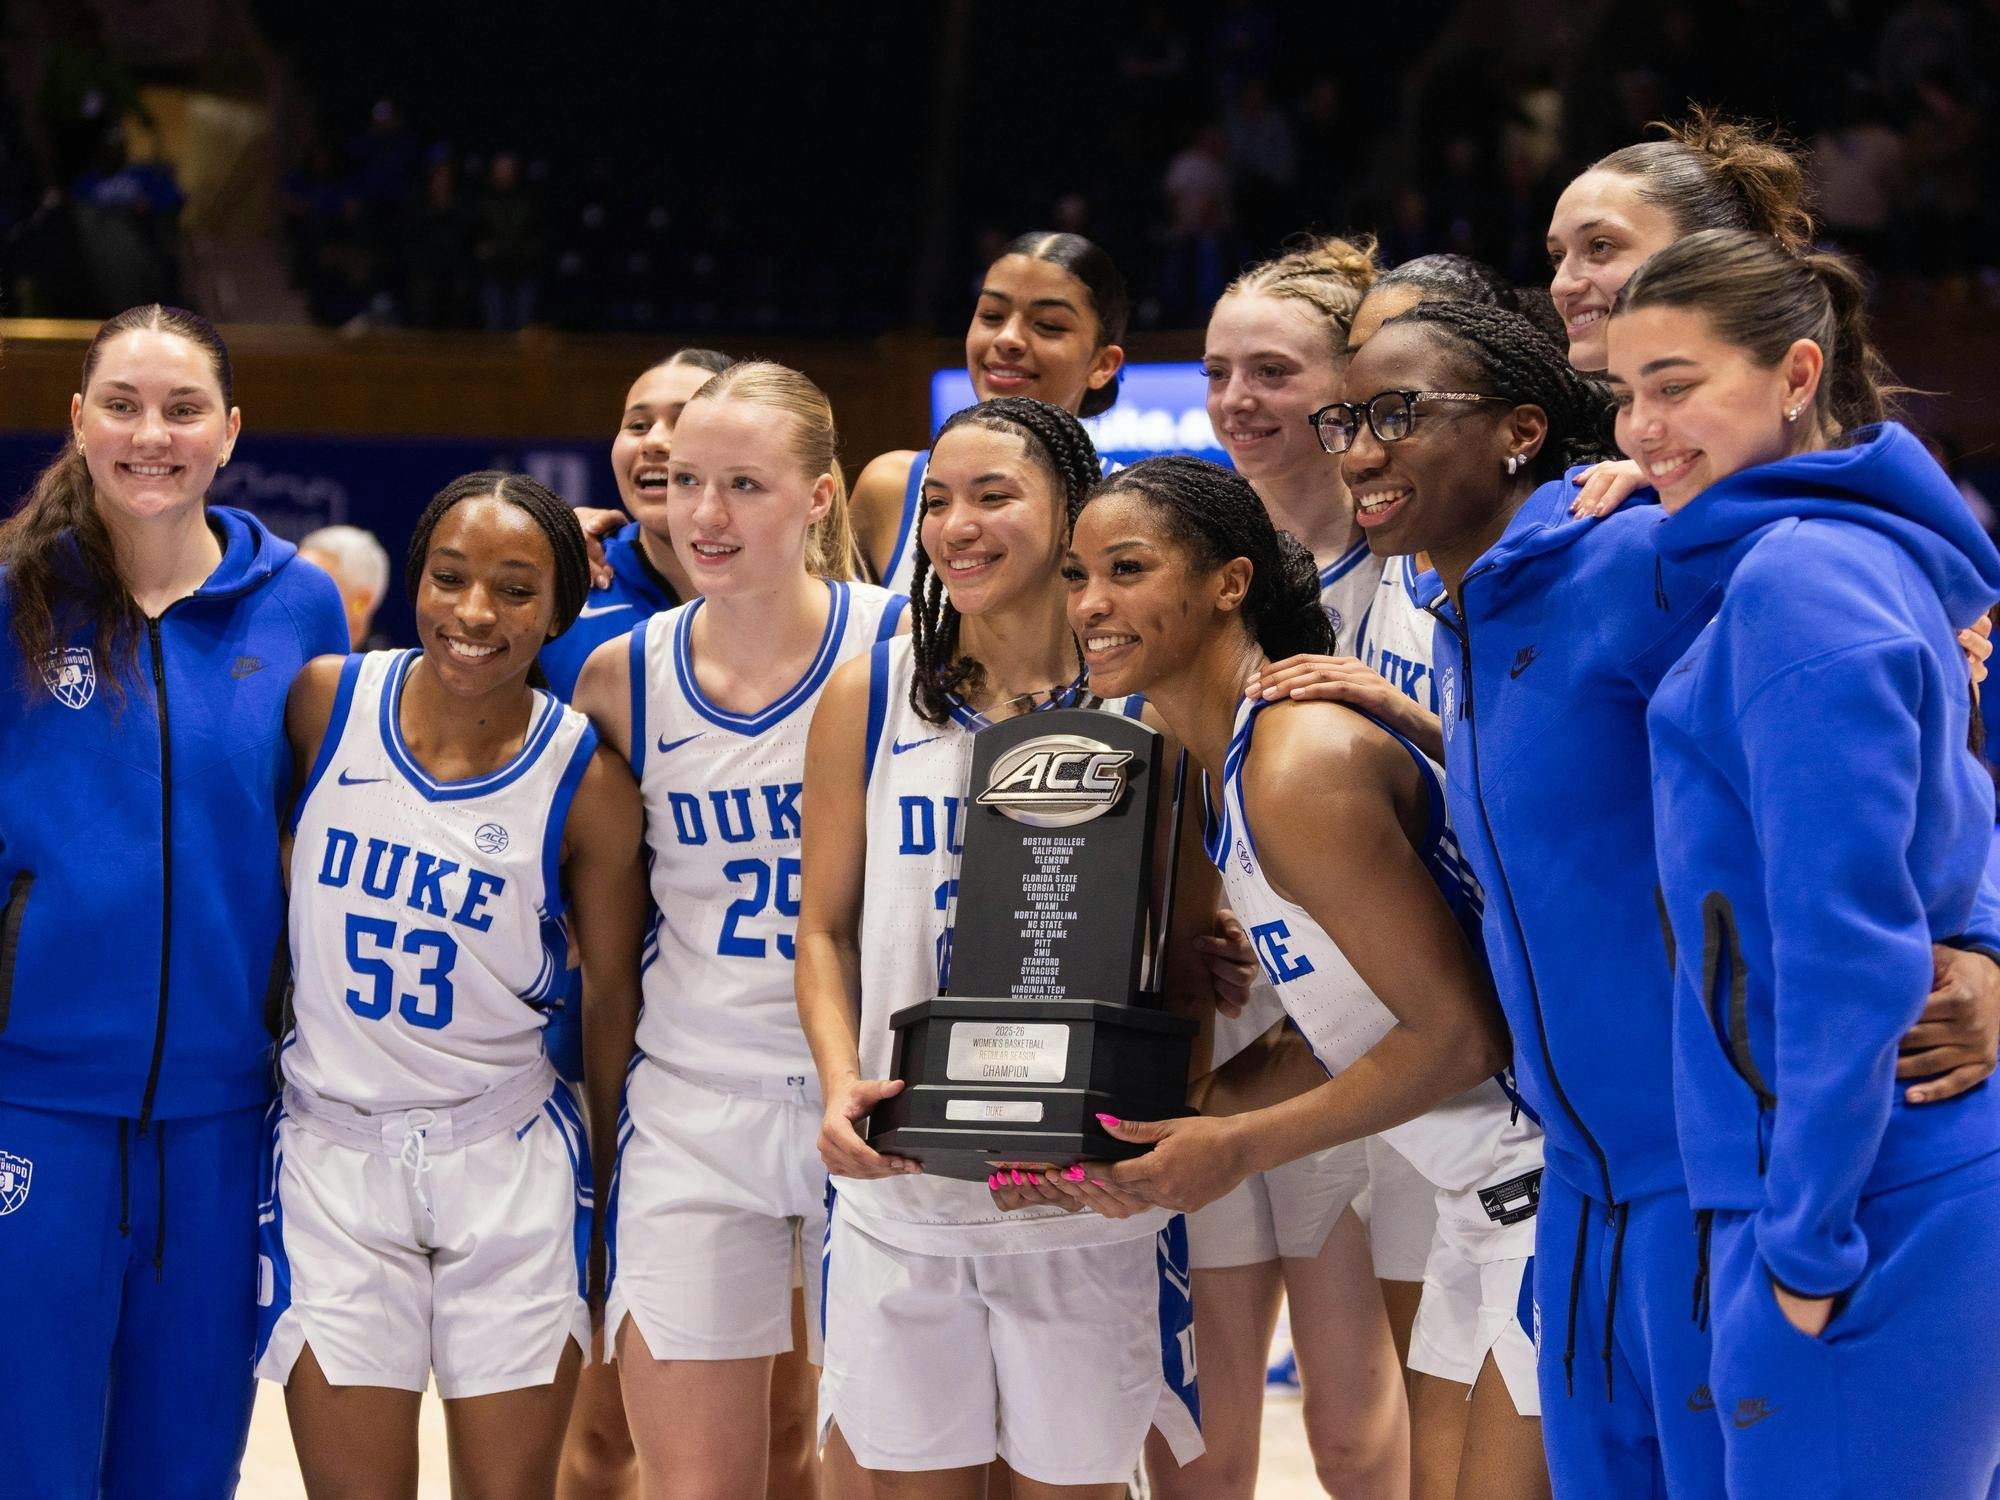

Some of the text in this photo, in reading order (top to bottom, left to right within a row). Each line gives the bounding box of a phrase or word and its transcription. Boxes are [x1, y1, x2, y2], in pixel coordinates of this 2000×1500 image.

[992, 752, 1131, 792] ACC
[1022, 837, 1086, 846] BOSTON COLLEGE
[1032, 847, 1074, 855] CALIFORNIA
[1034, 856, 1070, 864] CLEMSON
[1041, 865, 1061, 874] DUKE
[318, 827, 505, 933] DUKE
[1022, 874, 1078, 883] FLORIDA STATE
[1022, 883, 1076, 892] GEORGIA TECH
[1027, 893, 1069, 901] LOUISVILLE
[1035, 902, 1059, 911] MIAMI
[1014, 911, 1078, 920] NORTH CAROLINA
[1027, 920, 1063, 929] NC STATE
[1020, 929, 1068, 939] NOTRE DAME
[1034, 939, 1052, 947] PITT
[1033, 948, 1050, 957] SMU
[1022, 957, 1059, 966] STANFORD
[346, 912, 458, 1031] 53
[1020, 966, 1060, 975] SYRACUSE
[1022, 976, 1056, 985] VIRGINIA
[1011, 985, 1066, 994] VIRGINIA TECH
[995, 1026, 1025, 1037] 2025-26
[973, 1038, 1044, 1049] WOMEN'S BASKETBALL
[983, 1064, 1029, 1078] CHAMPION
[985, 1106, 1004, 1116] DUKE
